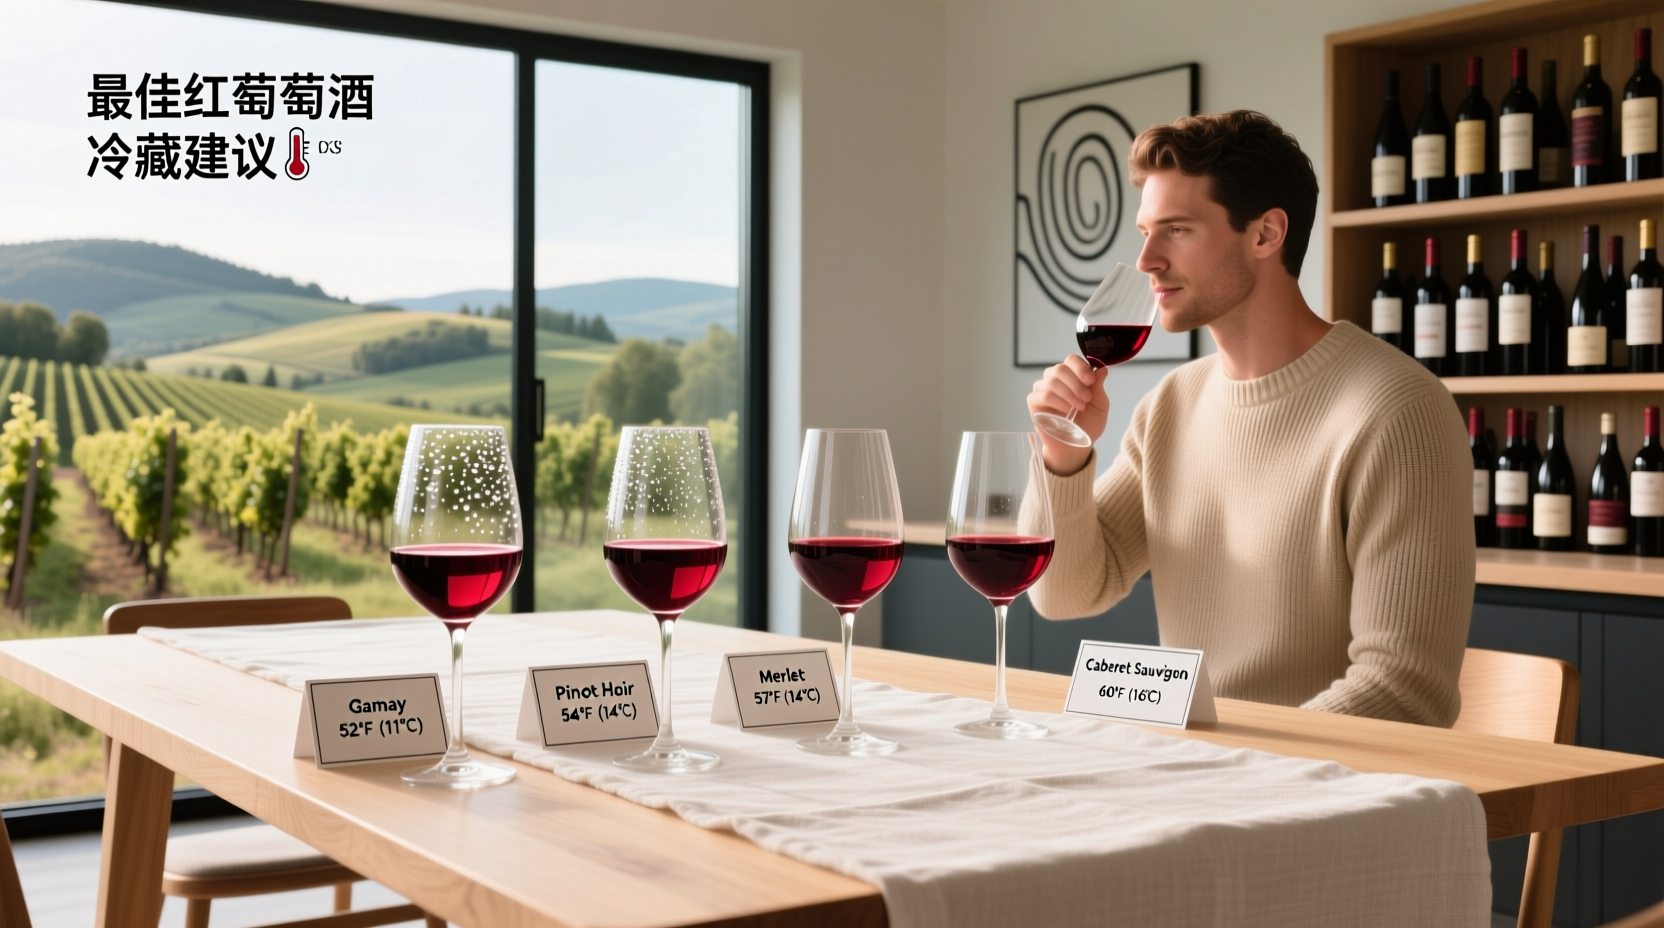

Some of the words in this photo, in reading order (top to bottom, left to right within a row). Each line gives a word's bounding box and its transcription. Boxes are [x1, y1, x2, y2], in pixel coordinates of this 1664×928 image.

[555, 684, 600, 701] Pinot
[601, 680, 635, 697] Hoir
[348, 698, 407, 716] Gamay
